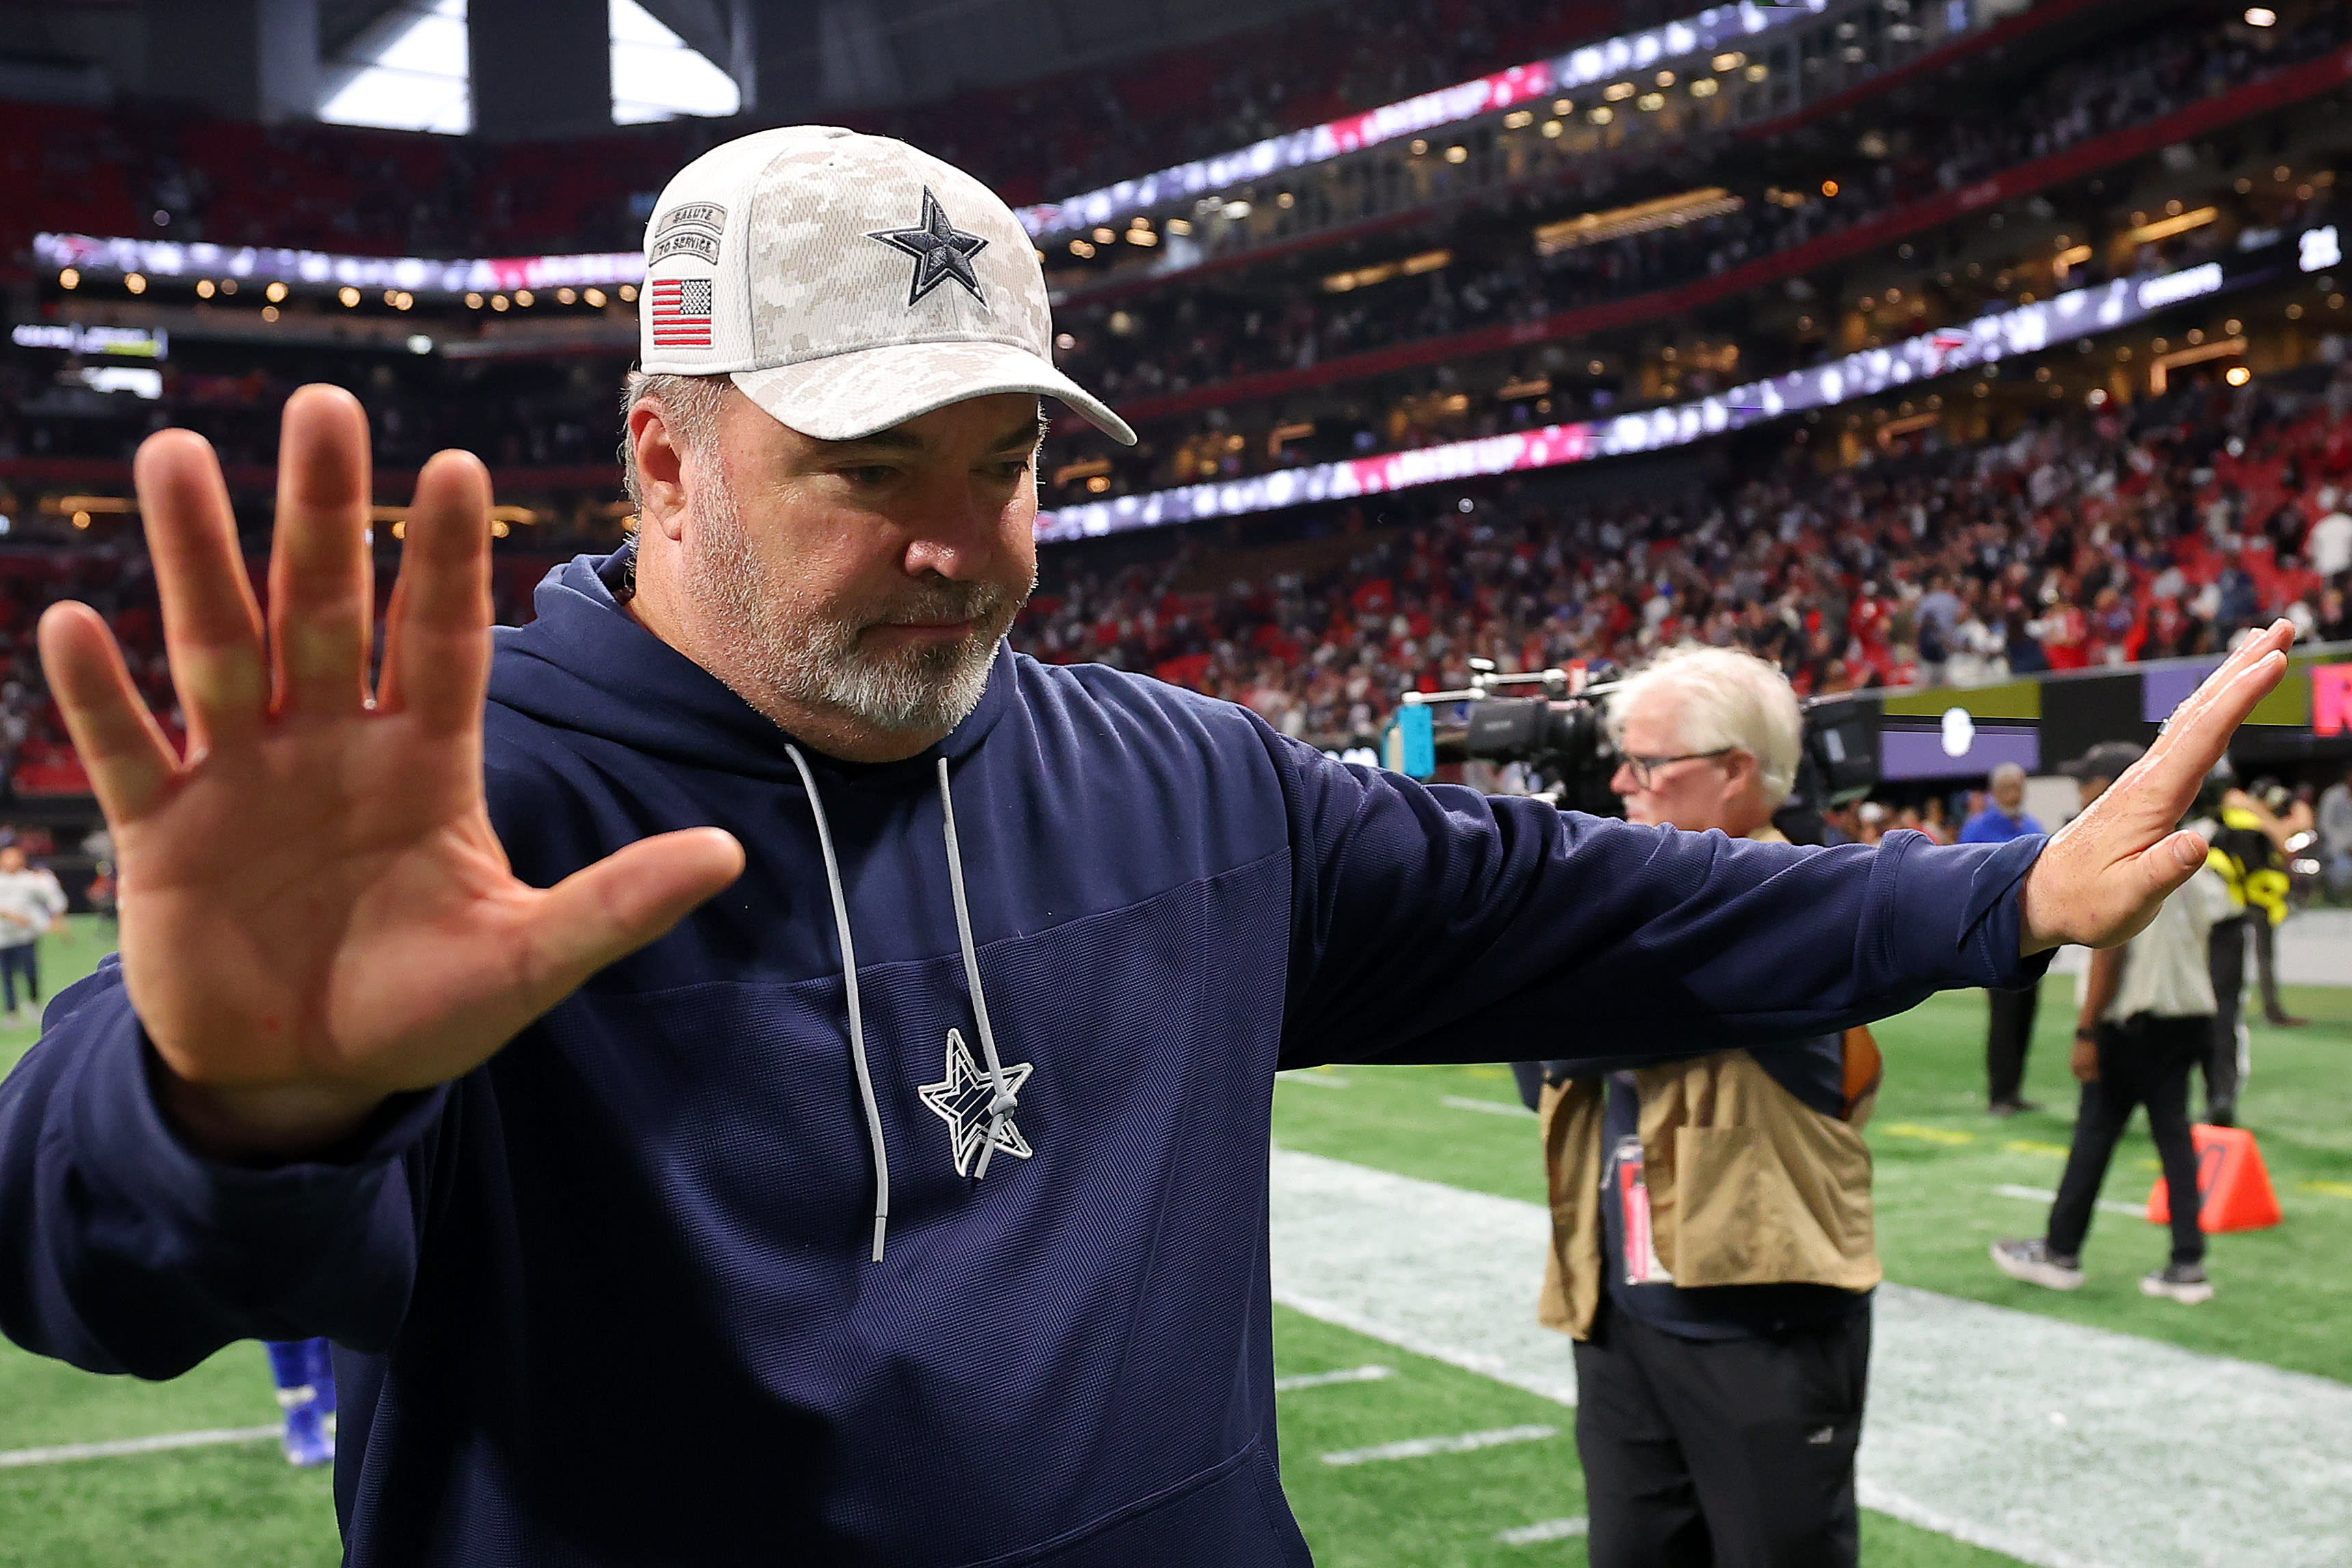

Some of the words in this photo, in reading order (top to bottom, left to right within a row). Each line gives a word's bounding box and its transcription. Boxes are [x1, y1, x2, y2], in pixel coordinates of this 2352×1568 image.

[673, 207, 713, 223] SALUTE
[658, 242, 670, 256] TO
[672, 236, 711, 253] SERVICE
